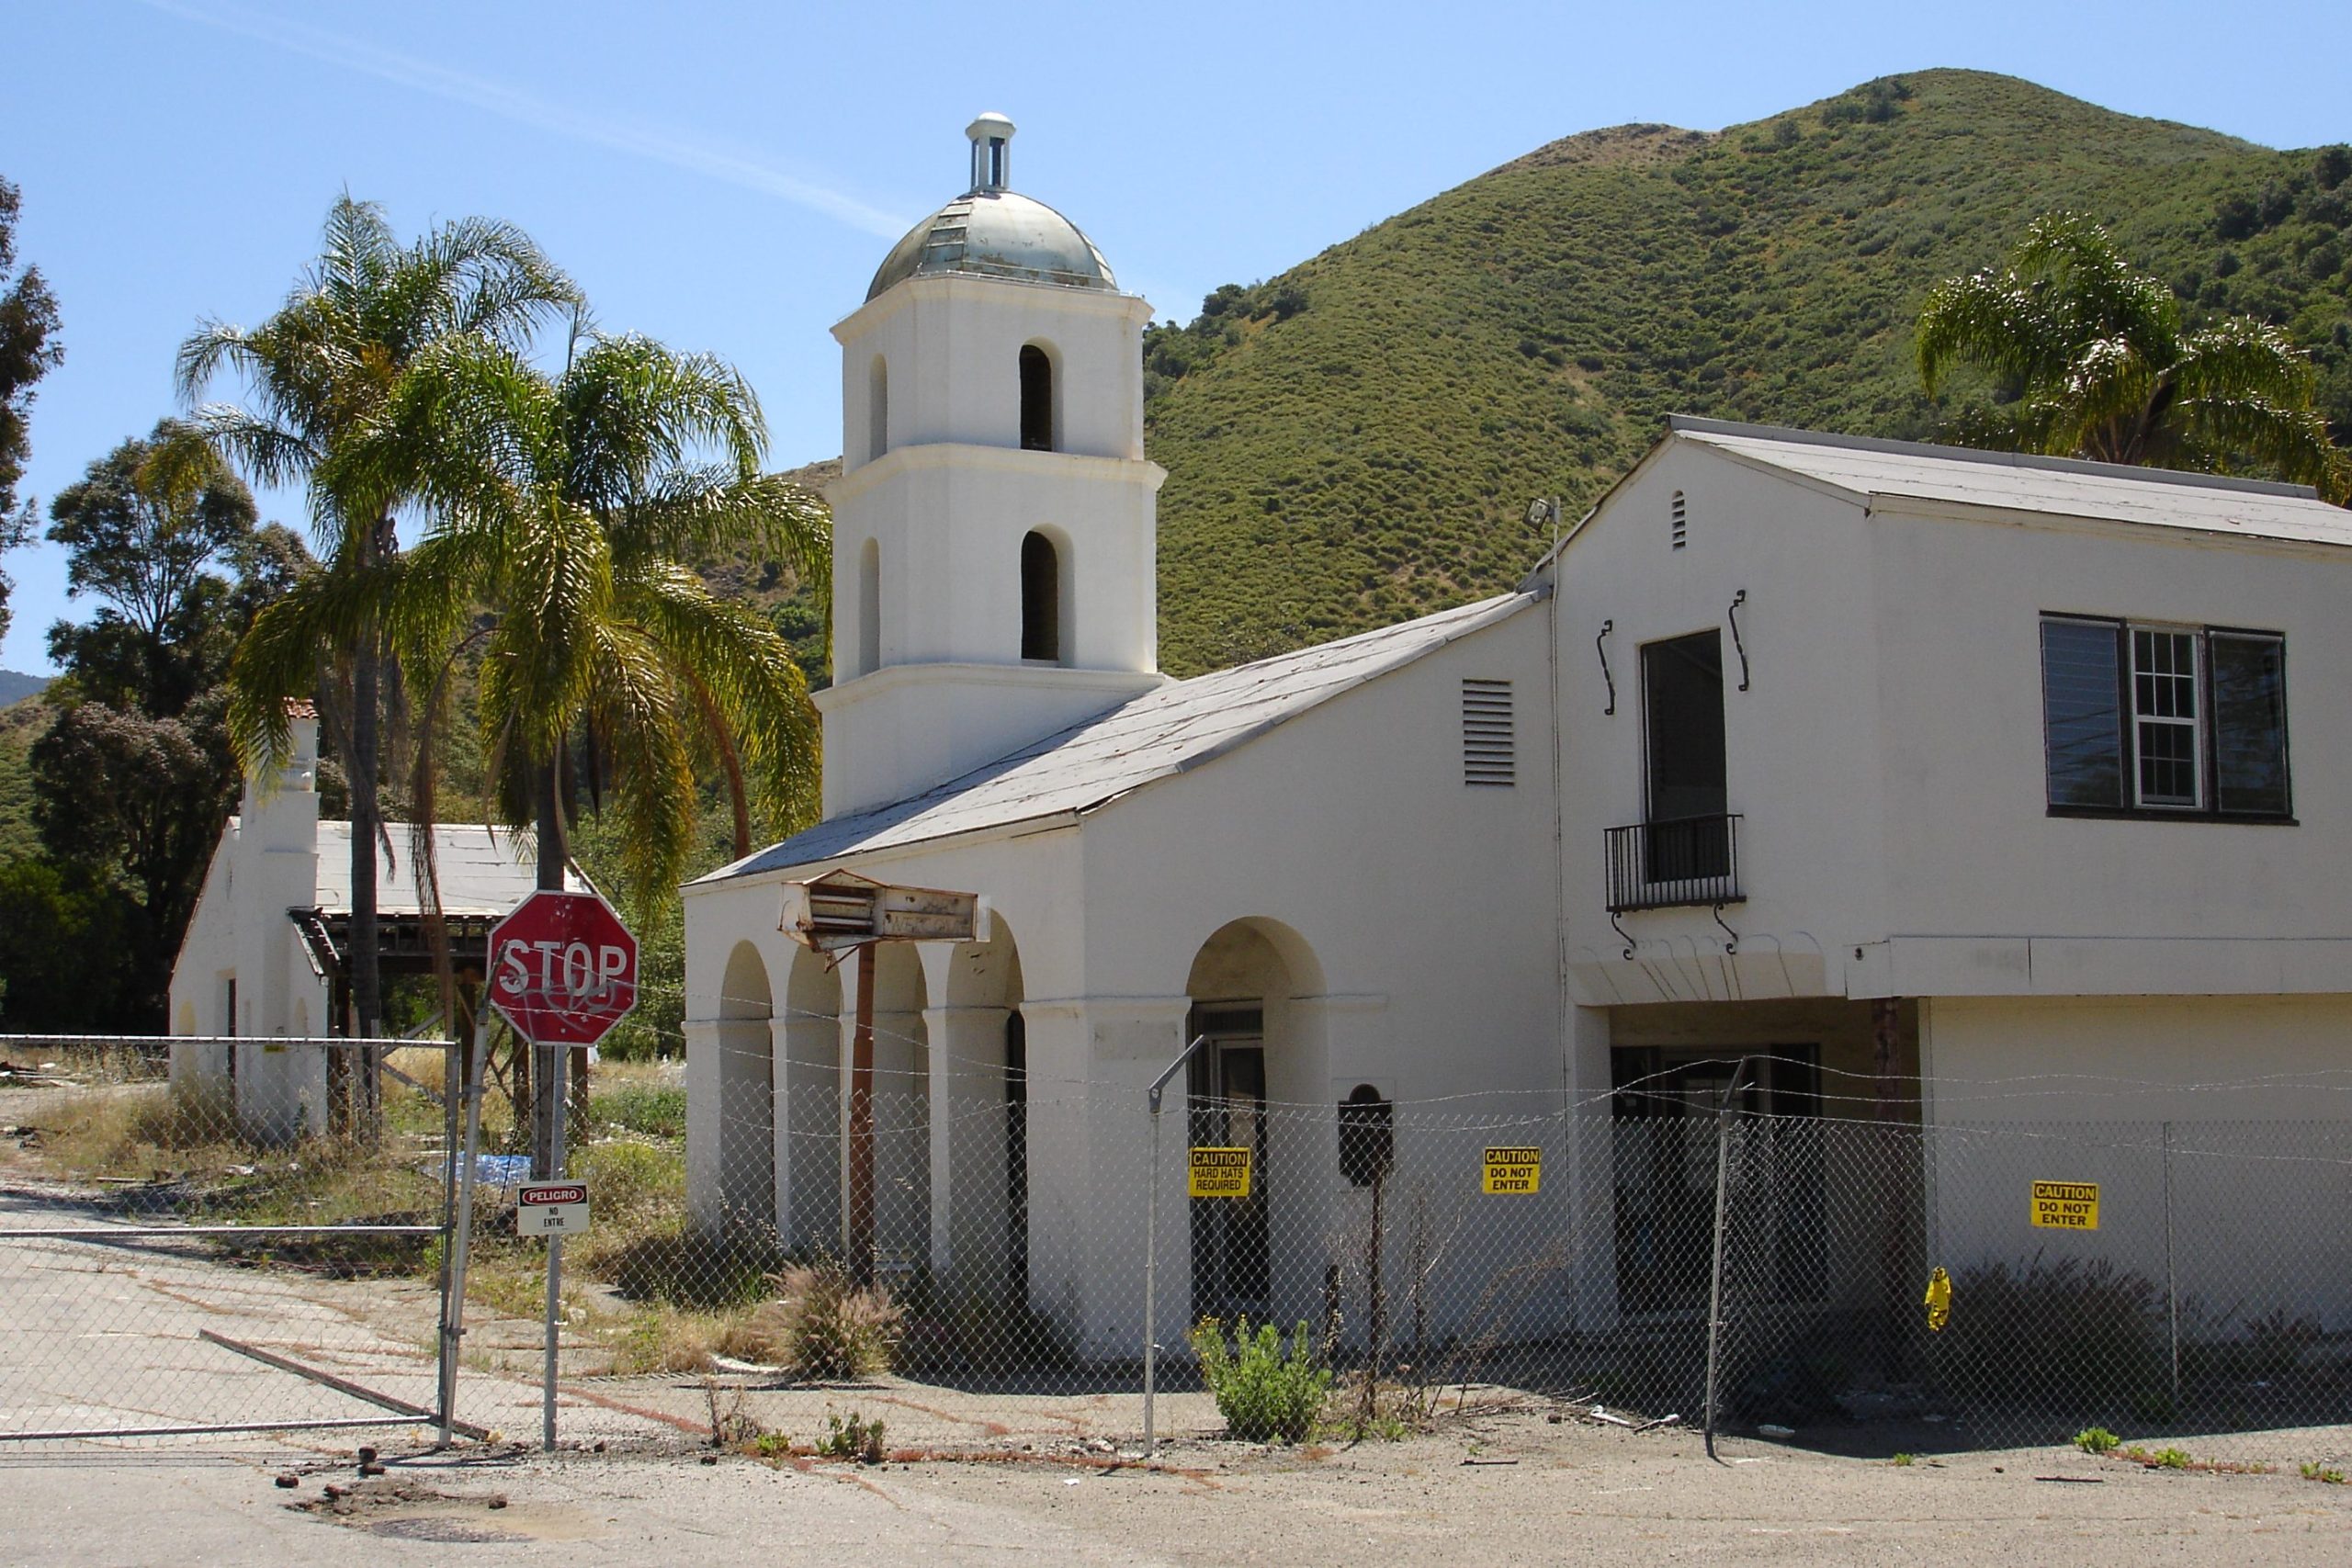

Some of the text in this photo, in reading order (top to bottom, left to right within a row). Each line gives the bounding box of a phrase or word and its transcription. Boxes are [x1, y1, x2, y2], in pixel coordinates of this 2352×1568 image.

[499, 939, 628, 998] STOP
[1193, 1153, 1246, 1165] CAUTION
[1486, 1150, 1539, 1163] CAUTION
[1193, 1168, 1244, 1179] HARD HATS
[1490, 1168, 1532, 1178] DO NOT
[1195, 1179, 1241, 1190] REQUIRED
[1492, 1179, 1529, 1190] ENTER
[529, 1190, 577, 1201] PELIGRO
[2035, 1185, 2095, 1200] CAUTION
[548, 1206, 559, 1216] NO
[2039, 1201, 2091, 1213] DO NOT
[544, 1217, 565, 1227] ENTRE
[2042, 1213, 2086, 1225] ENTER
